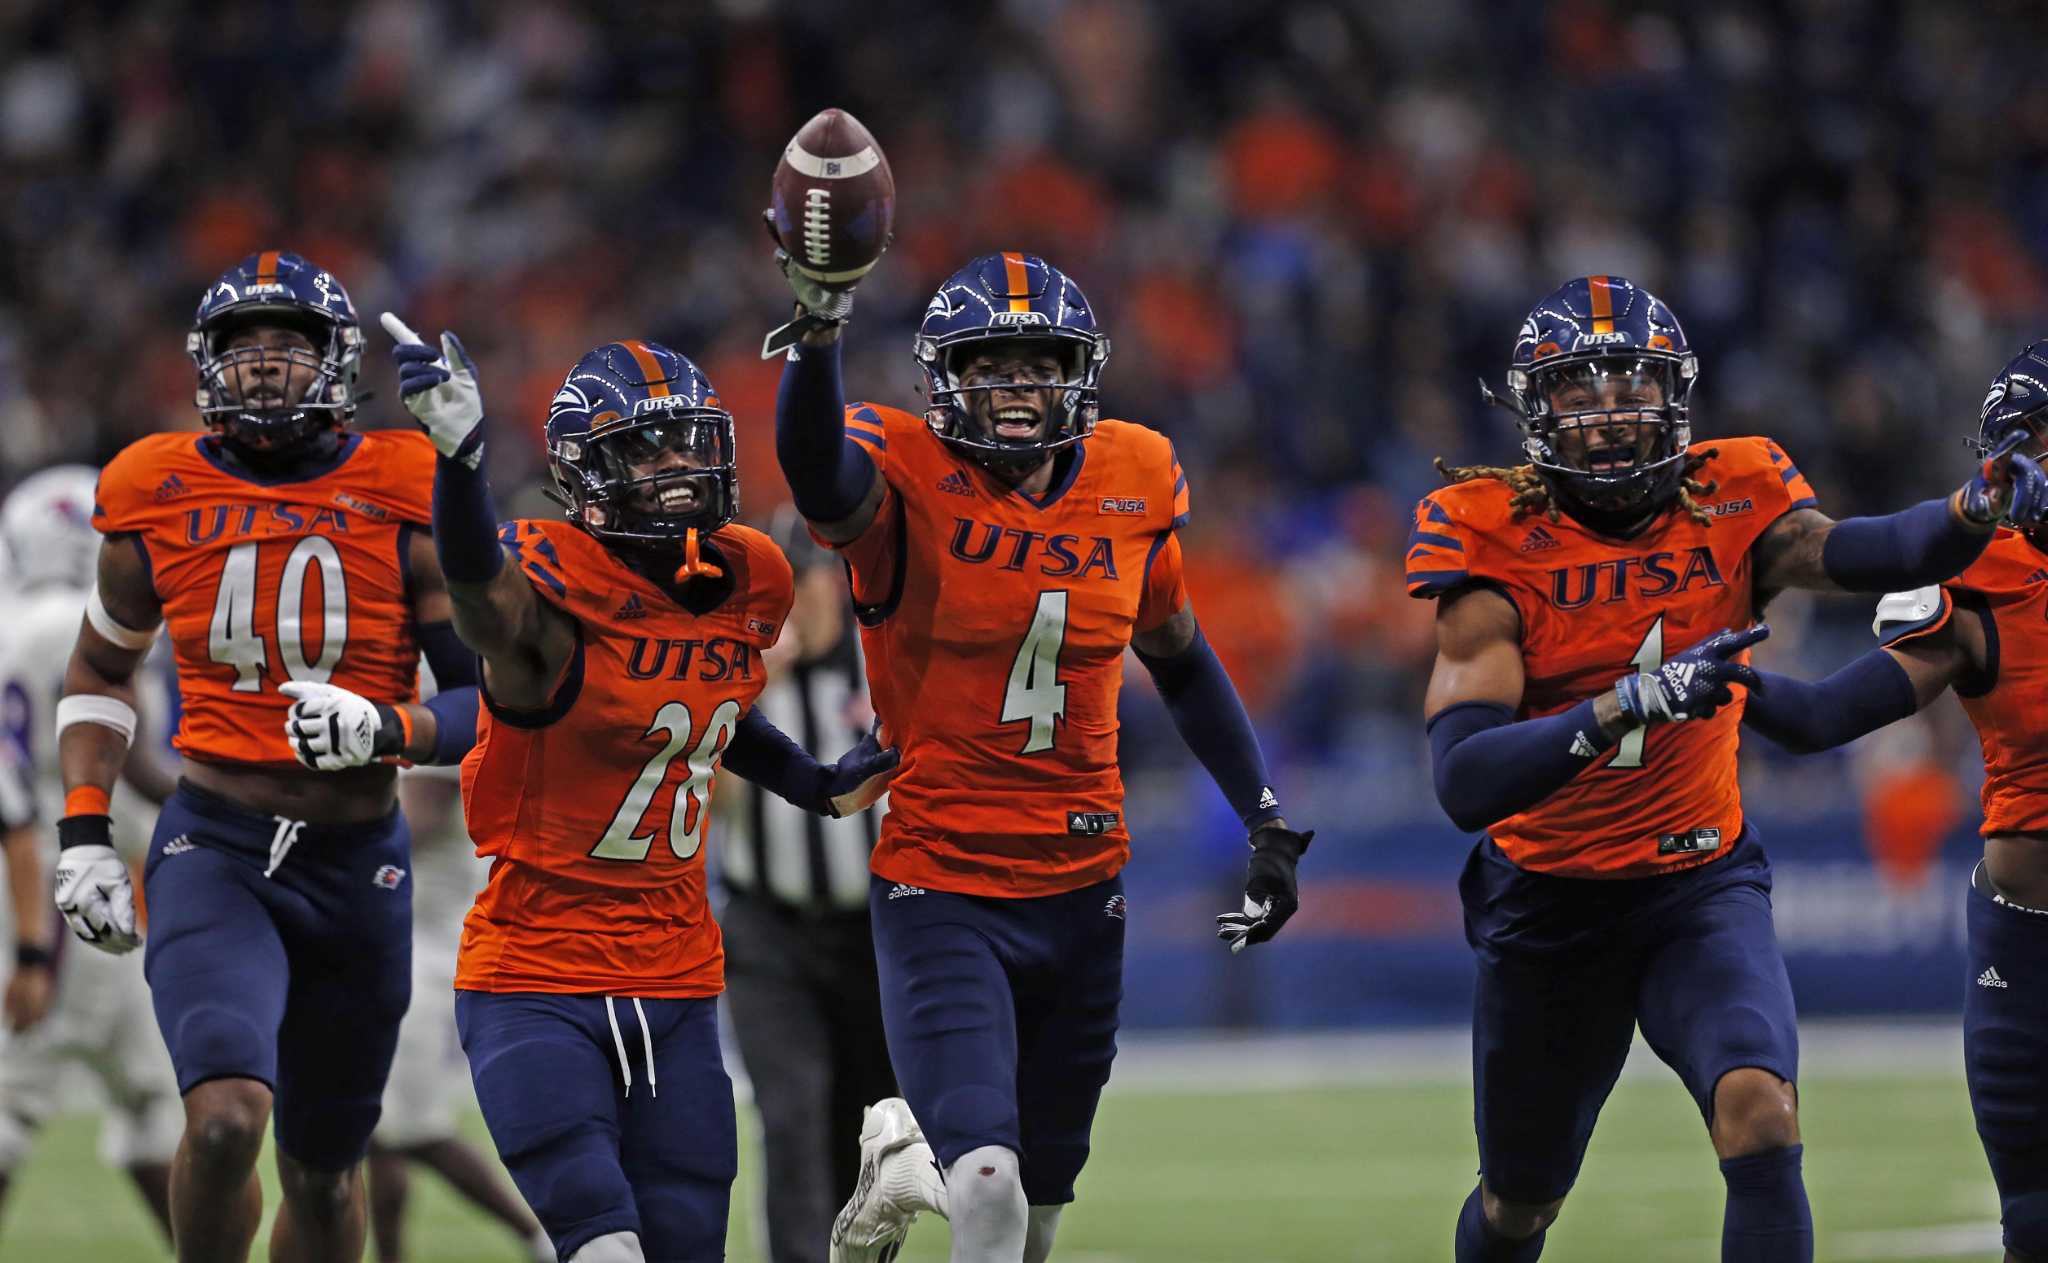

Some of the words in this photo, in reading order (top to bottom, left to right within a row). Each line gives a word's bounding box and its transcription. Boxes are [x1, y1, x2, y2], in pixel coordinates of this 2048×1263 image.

[245, 283, 284, 296] UTSA
[999, 314, 1041, 326] UTSA
[1583, 332, 1626, 345] UTSA
[643, 396, 684, 411] UTSA
[185, 502, 350, 546] UTSA
[950, 516, 1121, 581] UTSA
[1547, 548, 1726, 610] UTSA
[208, 534, 348, 692] 40
[627, 637, 754, 682] UTSA
[999, 589, 1069, 757] 4
[1606, 608, 1667, 769] 1
[1662, 664, 1688, 701] adidas
[587, 698, 741, 861] 28
[888, 887, 925, 900] adidas
[1977, 978, 2007, 987] adidas
